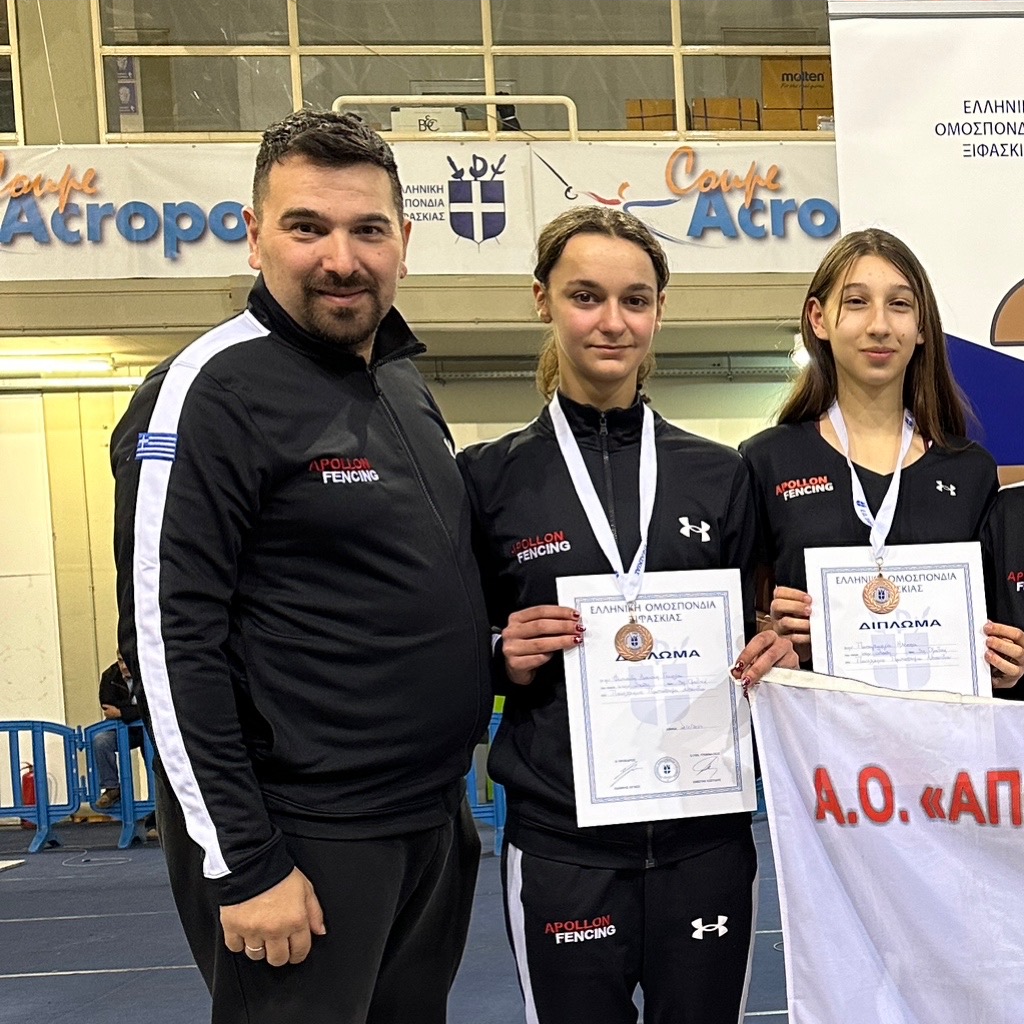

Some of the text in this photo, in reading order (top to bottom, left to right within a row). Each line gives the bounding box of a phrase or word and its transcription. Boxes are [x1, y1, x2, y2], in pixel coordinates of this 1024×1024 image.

[782, 71, 825, 82] molten
[0, 152, 97, 214] oupe
[665, 146, 782, 209] Coupe
[402, 184, 444, 194] ΛΗΝΙΚΗ
[403, 198, 445, 208] ΠΟΝΔΙΑ
[0, 195, 250, 259] Acropo
[309, 457, 371, 471] APOLLON
[322, 469, 379, 484] FENCING
[775, 476, 828, 496] APOLLON
[783, 482, 834, 501] FENCING
[511, 530, 565, 554] APOLLON
[517, 540, 571, 564] FENCING
[887, 572, 957, 584] ΟΜΟΣΠΟΝΔΙΑ
[590, 600, 717, 615] ΕΛΛΗΝΙΚΗ ΟΜΟΣΠΟΝΔΙΑ
[859, 618, 941, 630] ΔΙΠΛΩΜΑ
[615, 649, 701, 662] ΔΛΩΜΑ
[814, 765, 911, 826] Α.Ο.
[544, 914, 612, 934] APOLLON
[555, 924, 617, 945] FENCING
